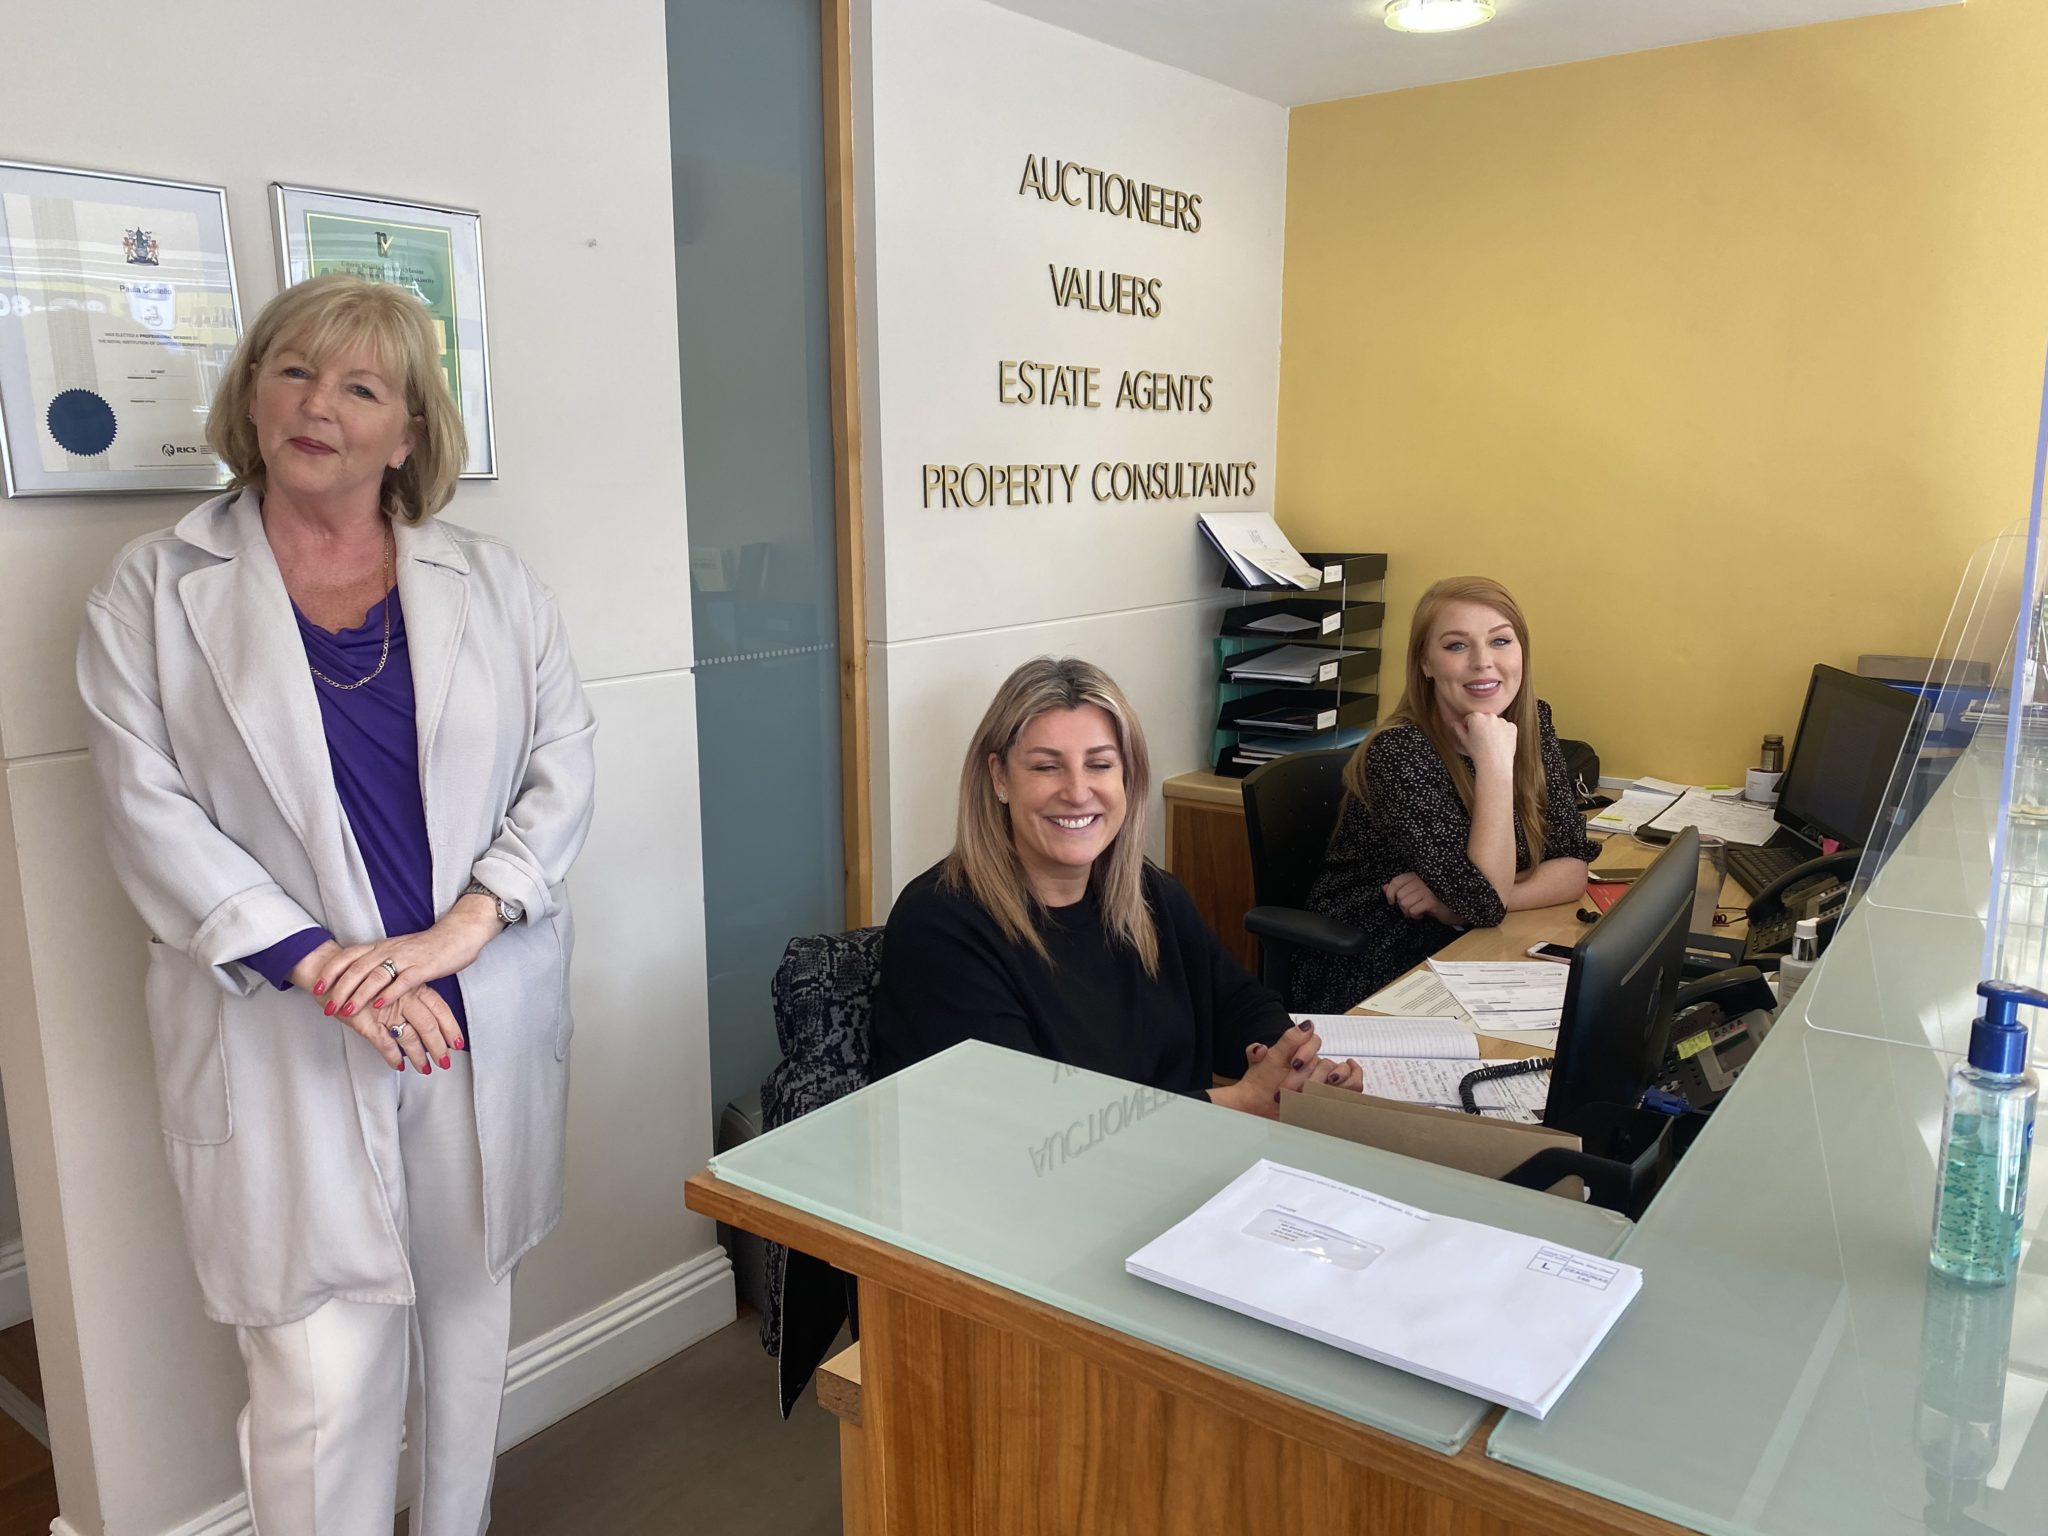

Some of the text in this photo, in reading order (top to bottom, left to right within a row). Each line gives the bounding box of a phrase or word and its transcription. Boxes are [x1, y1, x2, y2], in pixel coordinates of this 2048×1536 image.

[1019, 153, 1203, 233] AUCTIONEERS
[1048, 263, 1162, 318] VALUERS
[1000, 360, 1213, 413] ESTATE AGENTS
[176, 446, 197, 454] RICS
[923, 460, 1257, 508] PROPERTY CONSULTANTS
